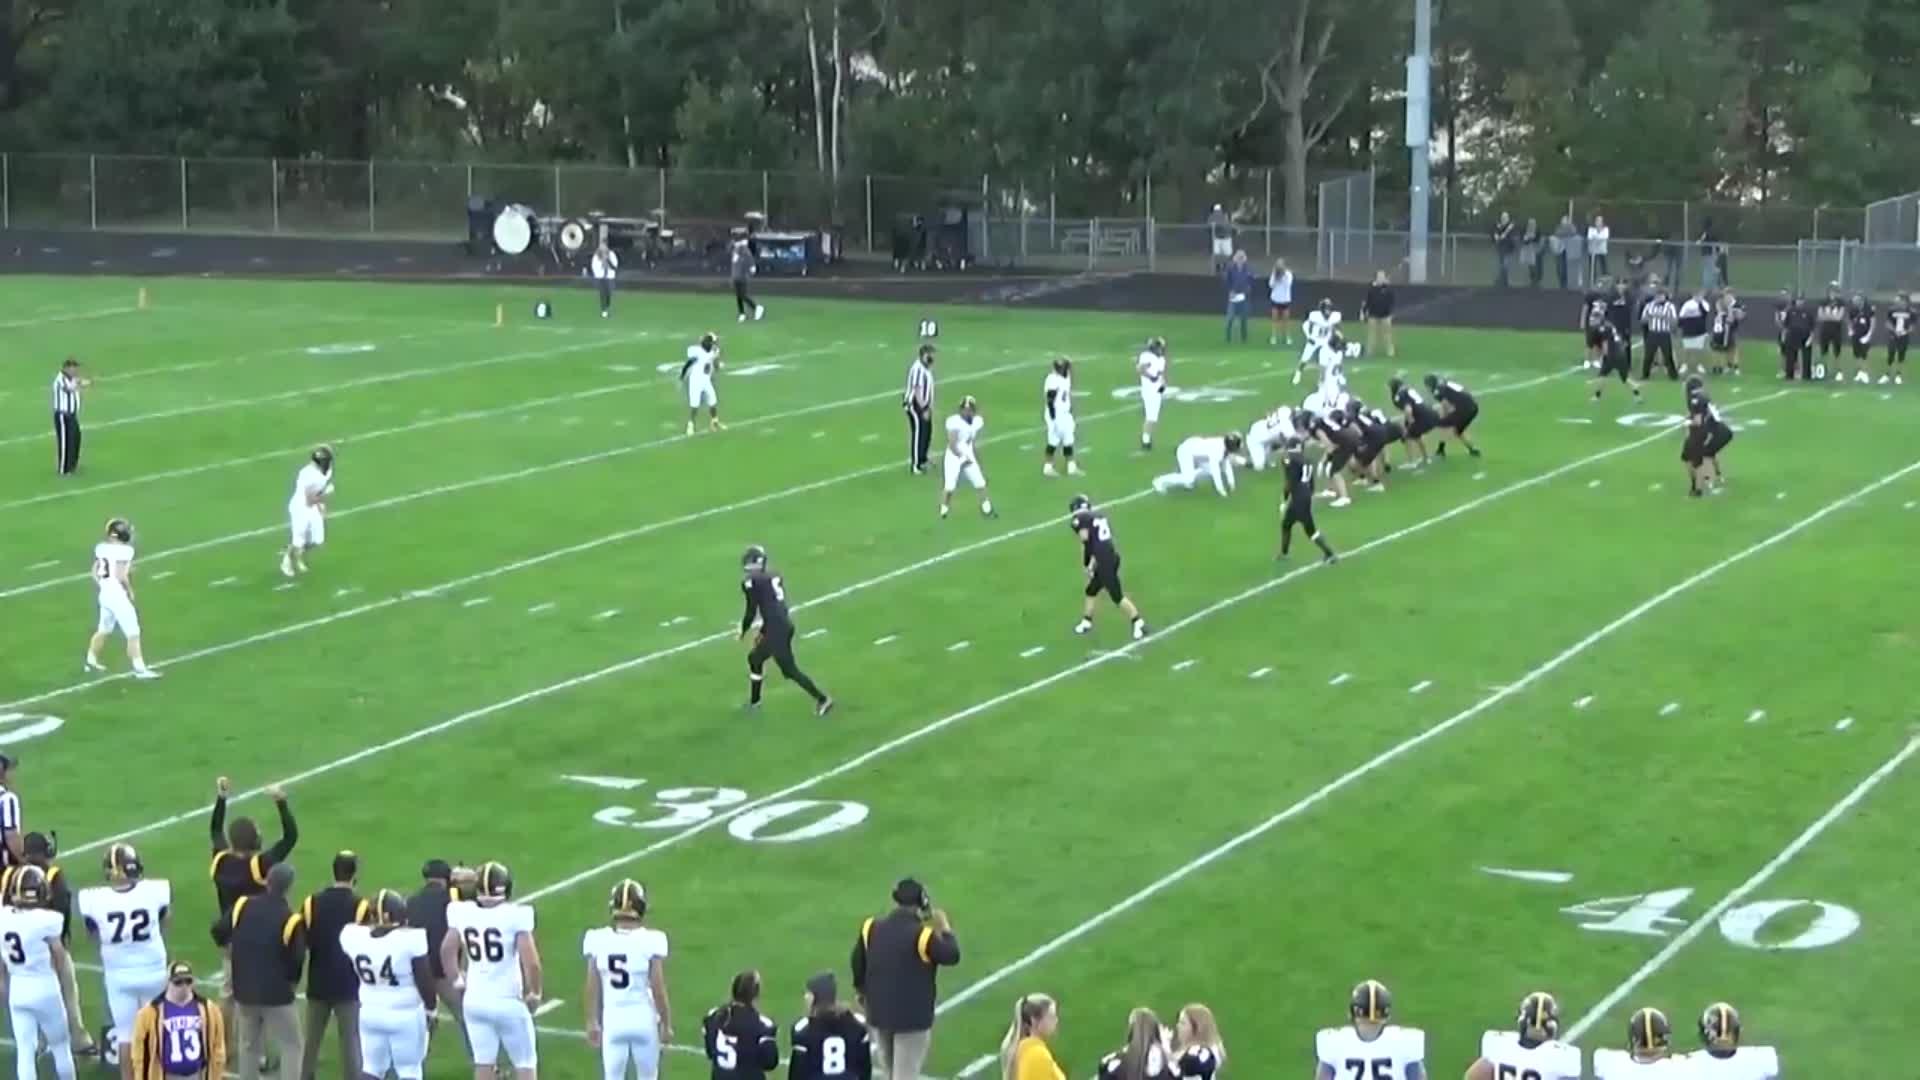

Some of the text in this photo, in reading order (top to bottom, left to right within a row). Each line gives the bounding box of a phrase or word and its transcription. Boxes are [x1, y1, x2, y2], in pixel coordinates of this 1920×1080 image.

[921, 321, 936, 337] 10
[592, 787, 869, 842] 30
[106, 908, 151, 944] 72
[1558, 887, 1862, 949] 40
[464, 928, 504, 963] 66
[355, 953, 399, 987] 64
[607, 954, 631, 989] 5
[170, 1029, 201, 1063] 13
[716, 1029, 738, 1070] 5
[822, 1036, 846, 1075] 8
[1345, 1057, 1393, 1080] 75
